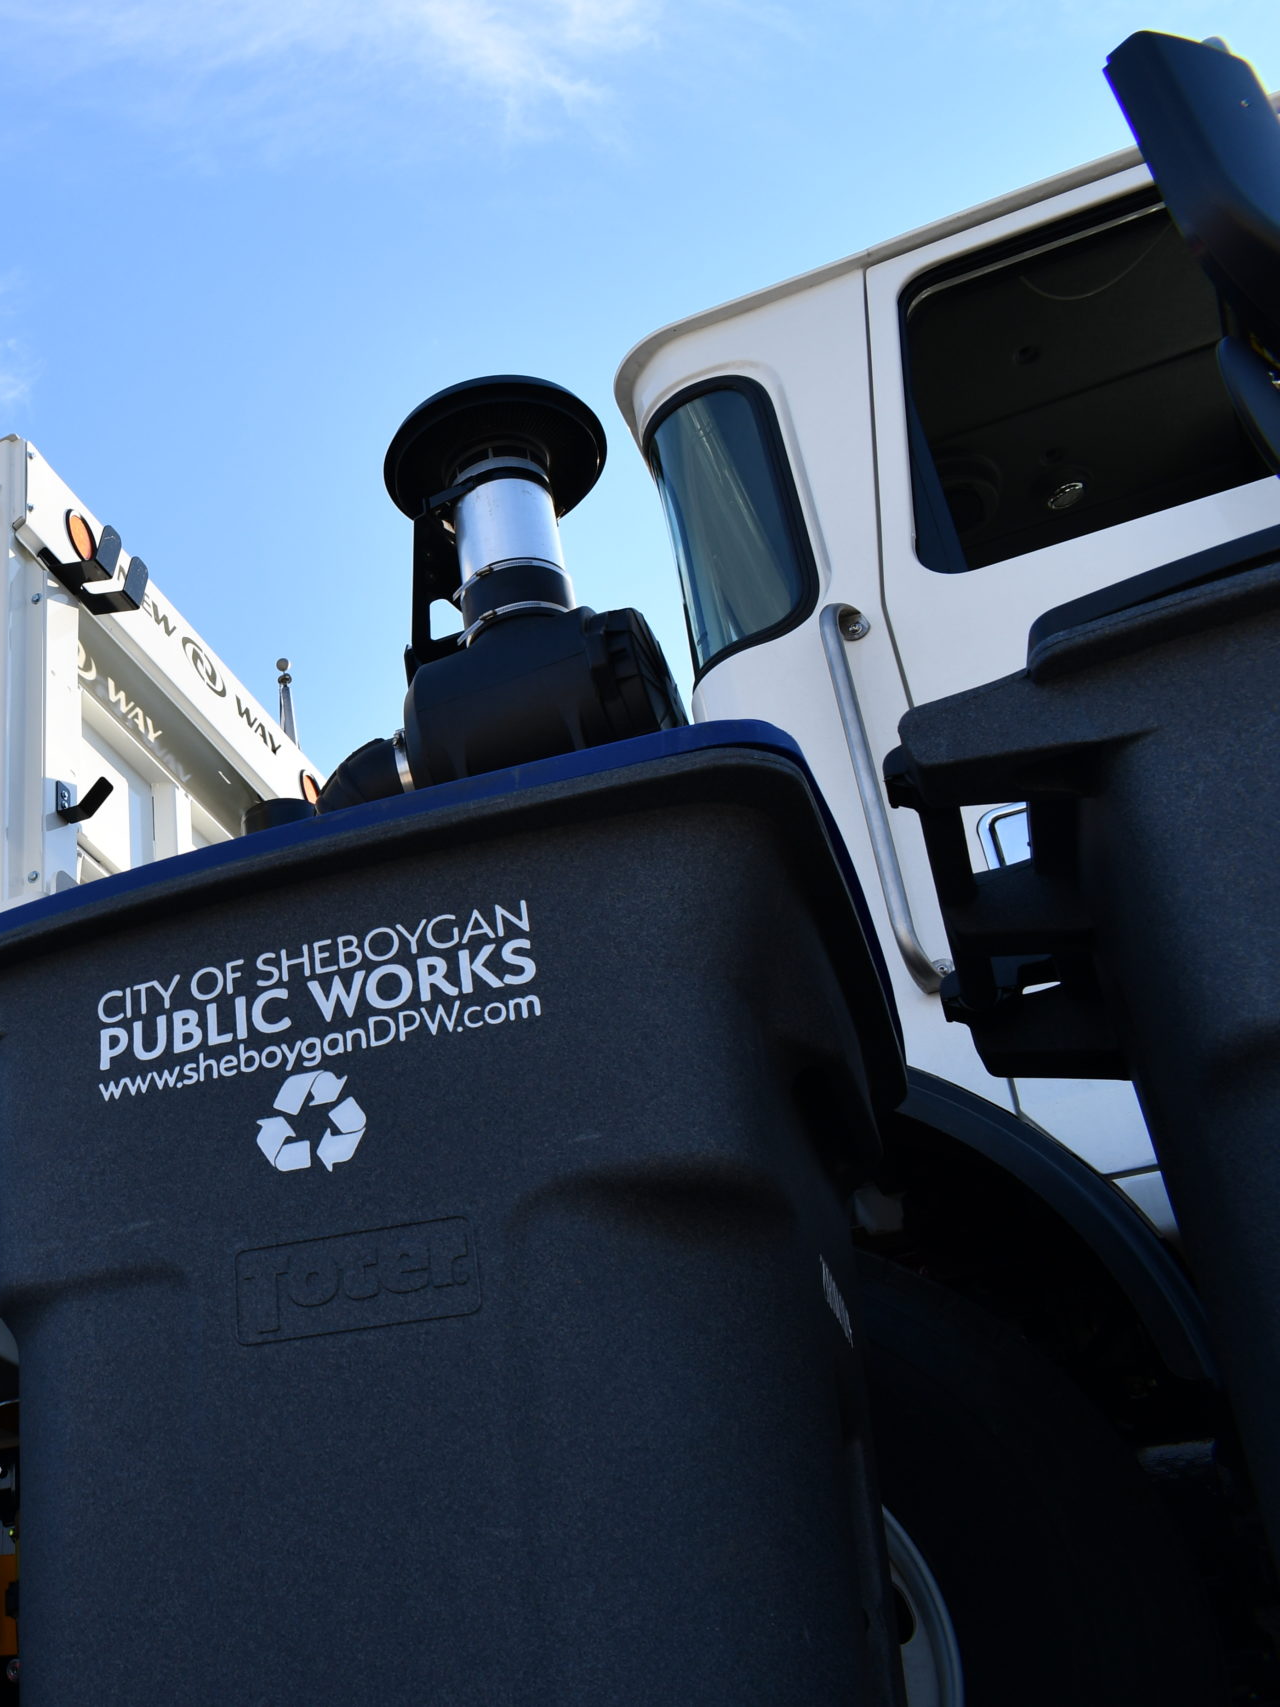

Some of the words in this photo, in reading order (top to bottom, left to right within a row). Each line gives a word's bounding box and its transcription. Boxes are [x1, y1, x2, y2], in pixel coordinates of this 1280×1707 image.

[107, 677, 163, 743] WAY
[235, 694, 282, 755] WAY
[98, 974, 181, 1024] CITY
[191, 959, 244, 1001] OF
[256, 900, 531, 987] SHEBOYGAN
[99, 988, 292, 1071] PUBLIC
[307, 938, 537, 1023] WORKS
[98, 994, 542, 1101] www.sheboyganDPW.com
